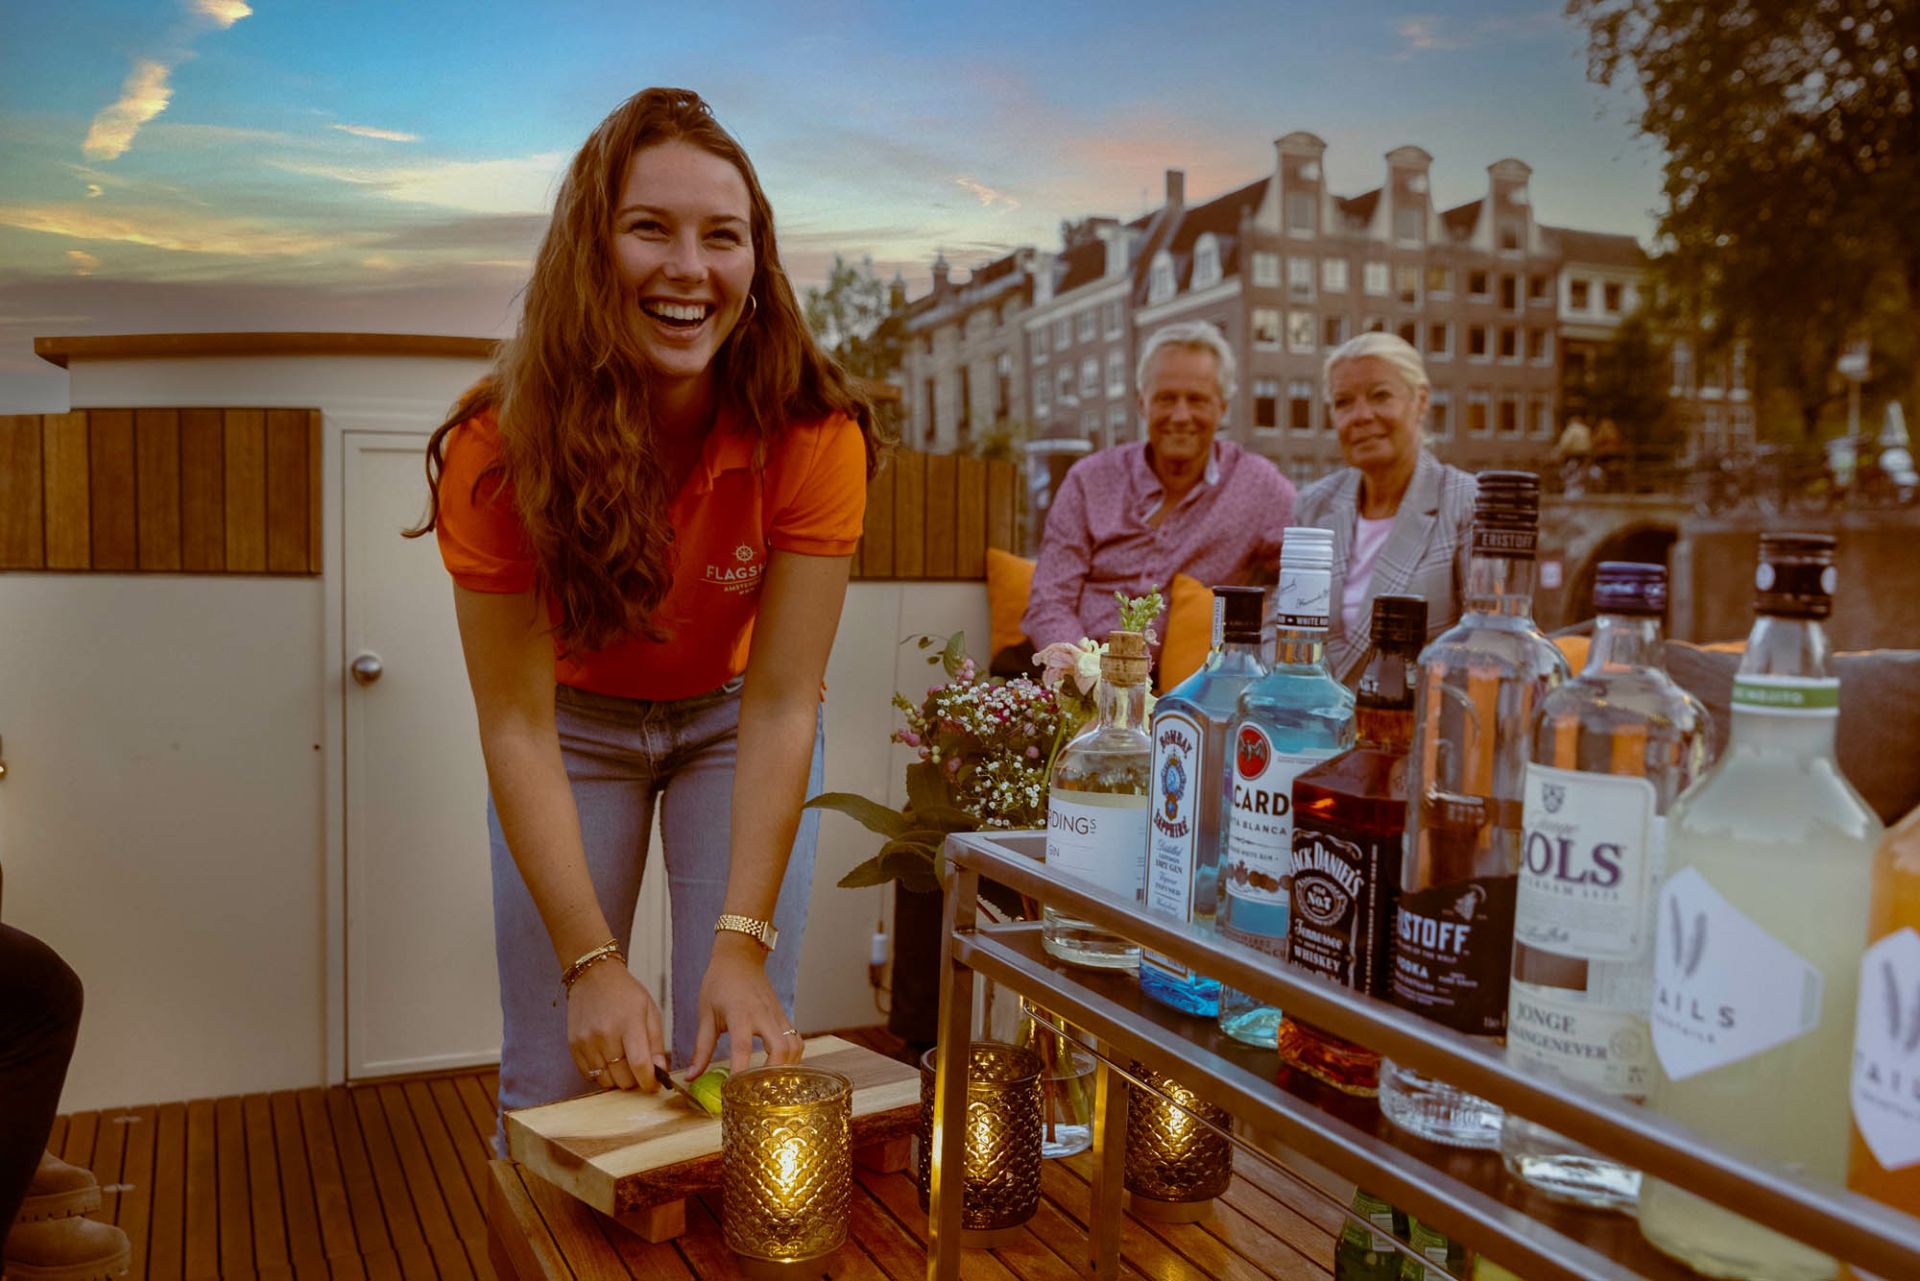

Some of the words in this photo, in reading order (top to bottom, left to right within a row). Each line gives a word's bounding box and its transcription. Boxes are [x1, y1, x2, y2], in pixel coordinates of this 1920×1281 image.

[1159, 729, 1193, 760] BOMBAY
[1153, 807, 1191, 838] SAPPHIRE
[1242, 820, 1288, 836] BLANCA
[1155, 859, 1169, 870] DRY
[1169, 864, 1184, 875] GIN
[1289, 846, 1314, 878] JACK
[1521, 830, 1627, 888] OLS
[1294, 945, 1341, 973] WHISKEY
[1516, 1001, 1576, 1033] JONGE
[1658, 986, 1737, 1031] AILS
